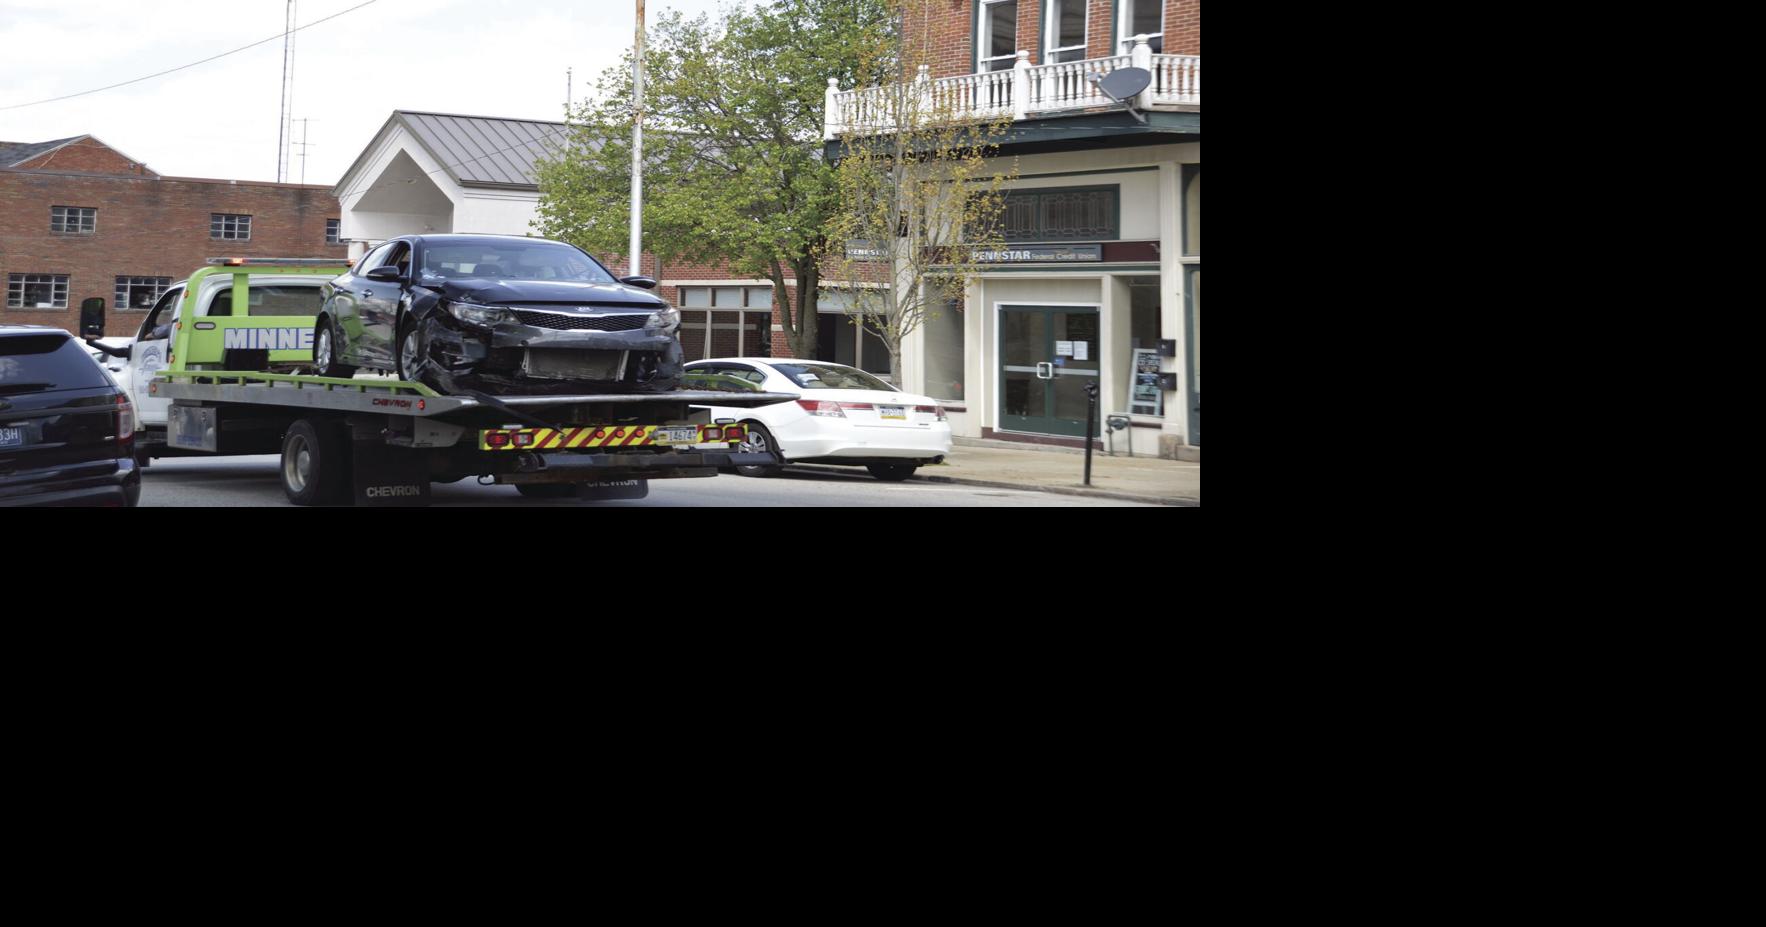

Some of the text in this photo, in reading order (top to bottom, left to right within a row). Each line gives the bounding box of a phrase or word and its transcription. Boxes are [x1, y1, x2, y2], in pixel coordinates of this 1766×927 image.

[1056, 252, 1076, 260] Credit
[224, 328, 314, 349] MINNE
[366, 485, 420, 497] CHEVRON
